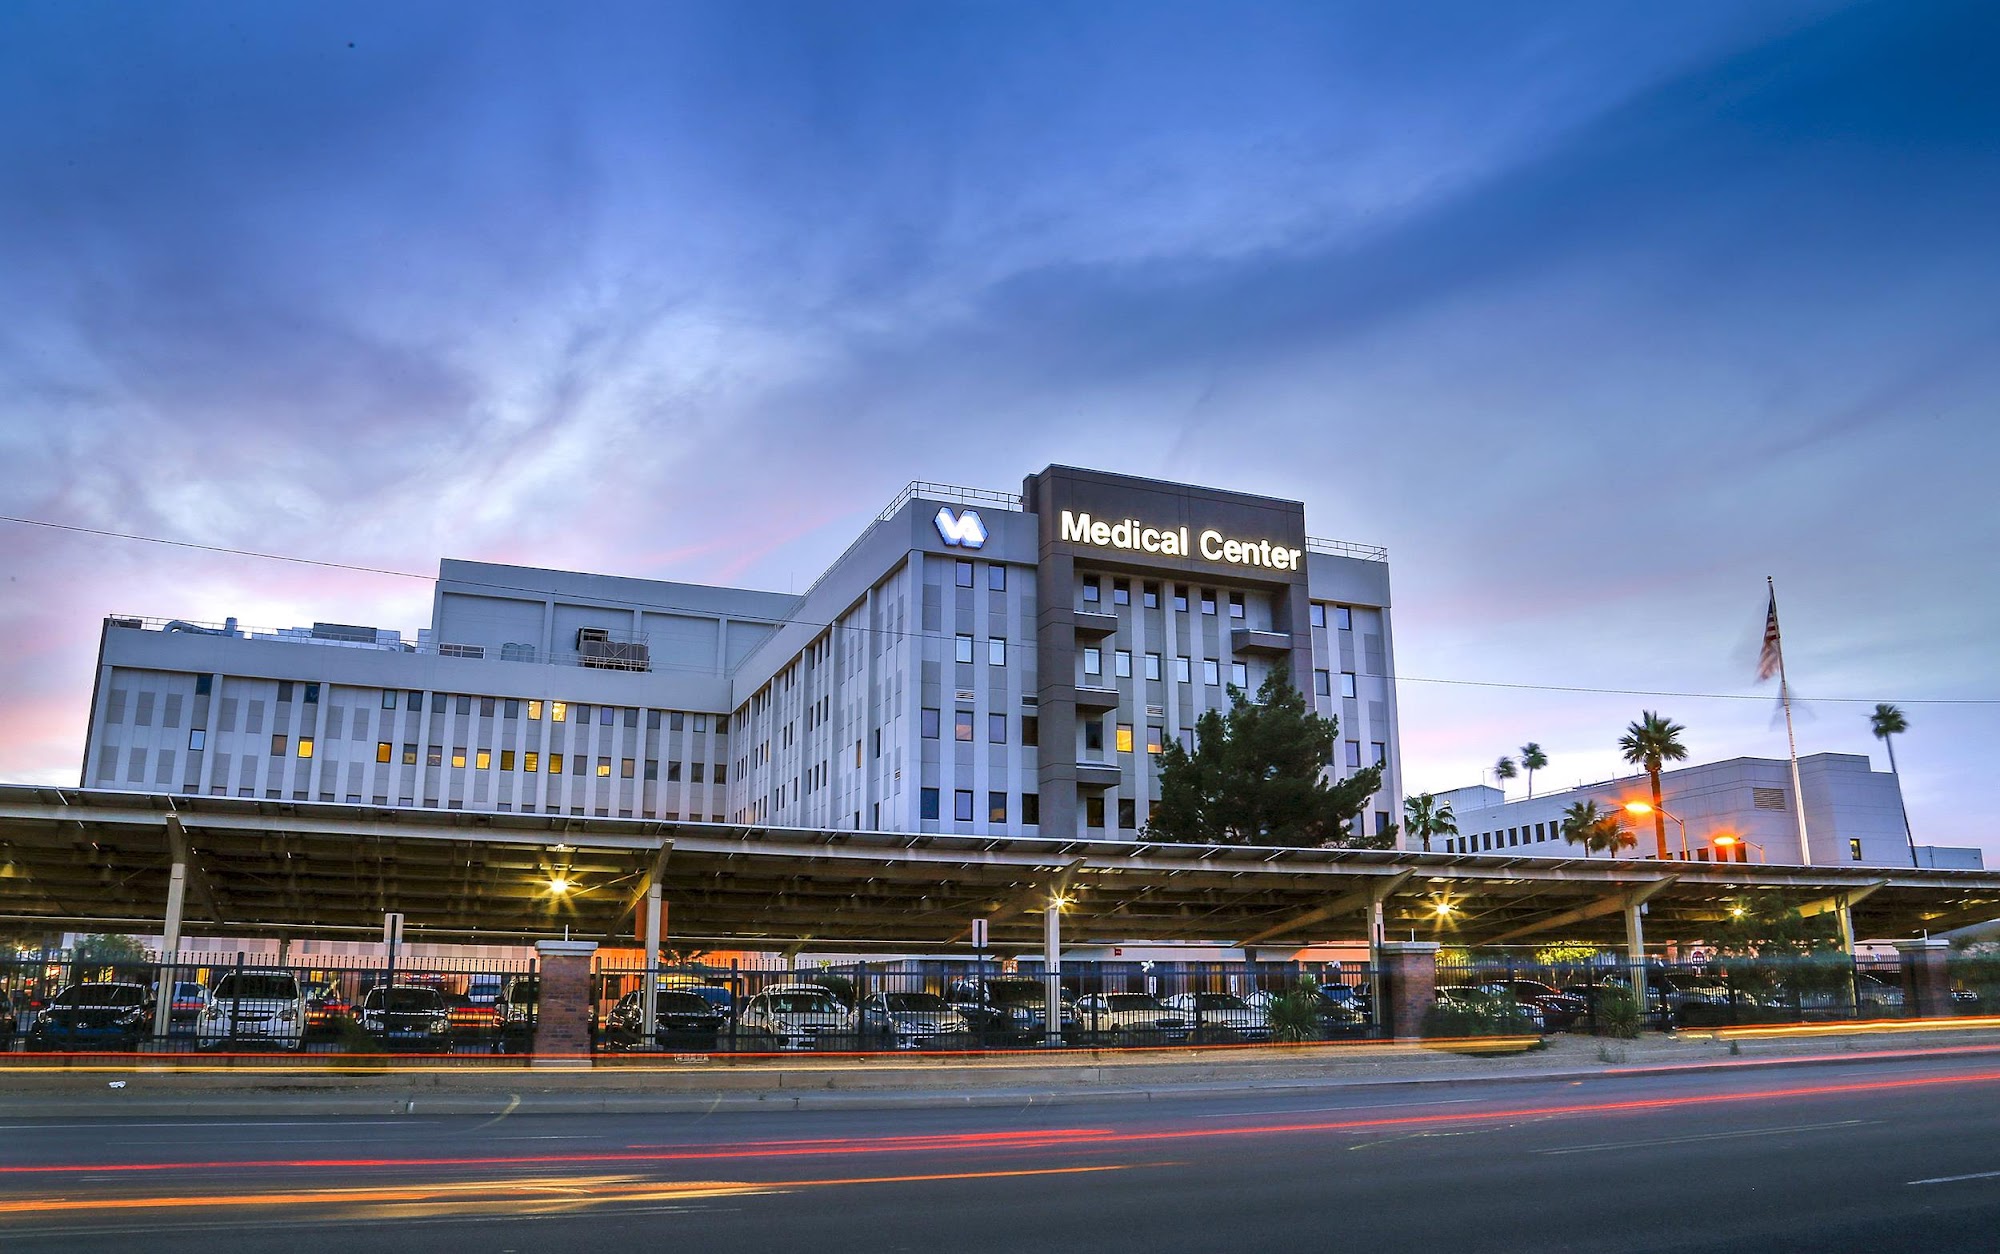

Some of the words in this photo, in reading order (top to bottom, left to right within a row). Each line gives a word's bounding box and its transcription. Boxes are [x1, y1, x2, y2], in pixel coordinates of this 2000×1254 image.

[935, 508, 987, 546] VA
[1061, 510, 1189, 556] Medical
[1200, 529, 1302, 571] Center
